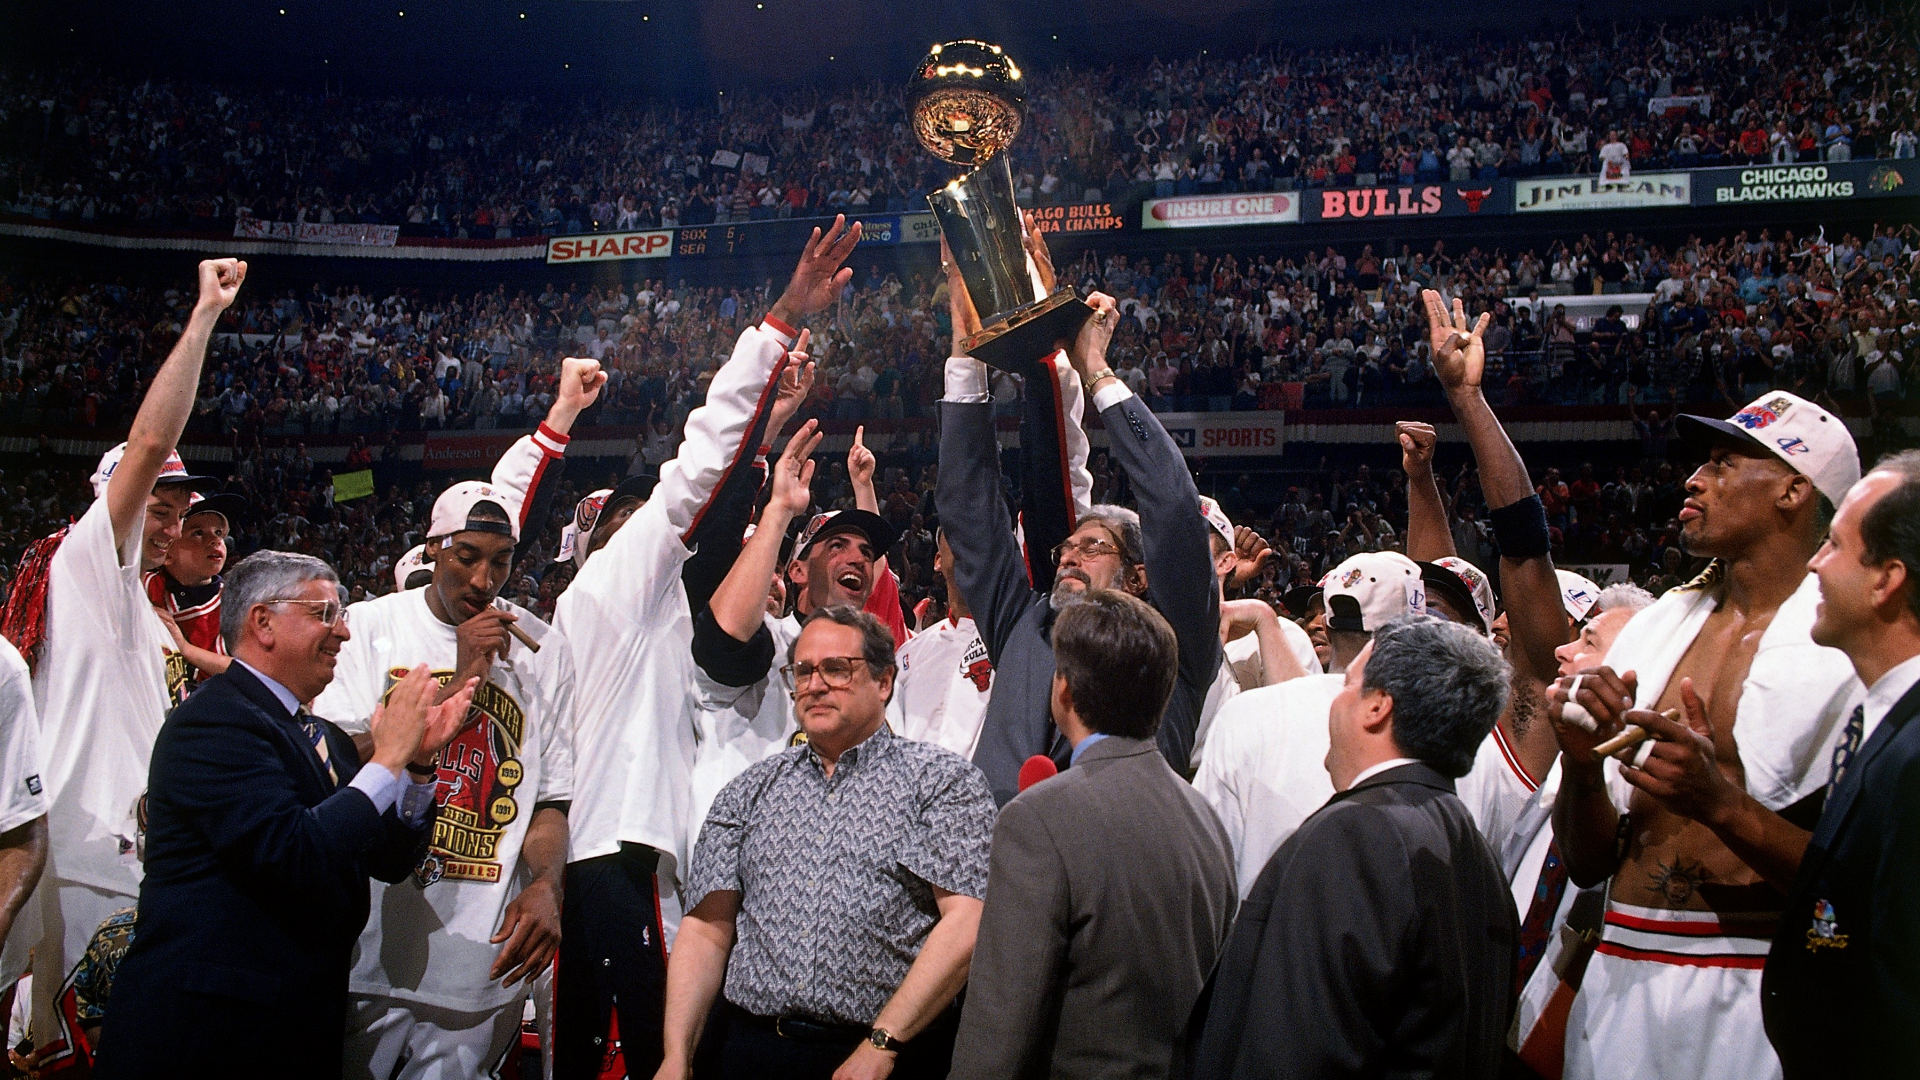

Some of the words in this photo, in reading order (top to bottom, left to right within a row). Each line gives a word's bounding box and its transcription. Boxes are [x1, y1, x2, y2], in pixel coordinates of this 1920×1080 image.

[1741, 166, 1828, 185] CHICAGO
[1519, 183, 1582, 209] JIM
[1716, 181, 1854, 202] BLACKHAWKS
[1069, 203, 1111, 218] BULLS
[1166, 200, 1232, 217] INSURE
[1235, 198, 1275, 215] ONE
[1321, 186, 1442, 218] BULLS
[681, 229, 707, 240] SOX
[727, 226, 736, 239] 6
[1065, 216, 1123, 231] CHAMPS
[551, 234, 670, 260] SHARP
[679, 243, 705, 255] SEA
[727, 241, 734, 253] 7
[1202, 428, 1276, 447] SPORTS
[425, 446, 481, 460] Andersen
[964, 647, 988, 663] BULL
[494, 690, 520, 740] EVER
[440, 742, 484, 783] LLS
[444, 807, 473, 825] NBA
[495, 804, 511, 815] 1991
[432, 820, 495, 857] PIONS
[448, 863, 497, 877] BULLS
